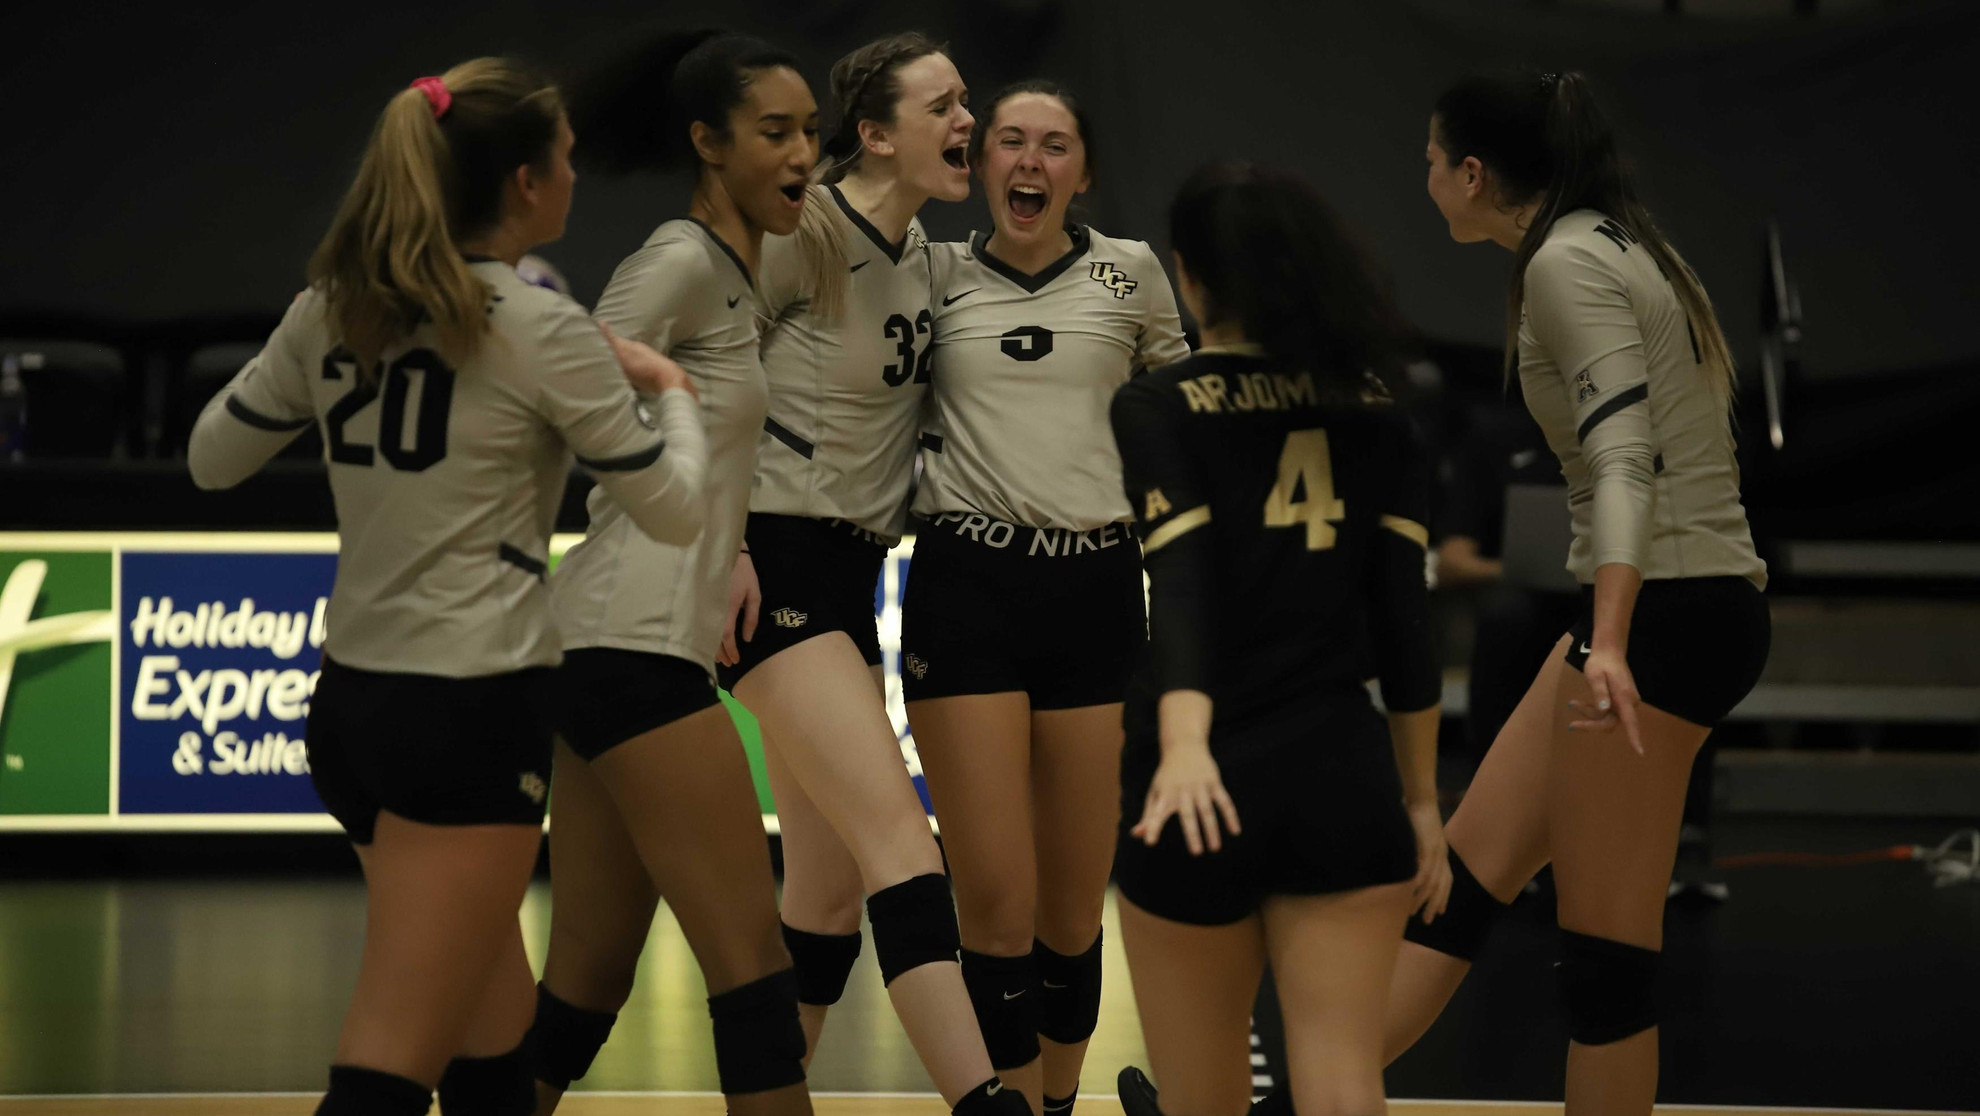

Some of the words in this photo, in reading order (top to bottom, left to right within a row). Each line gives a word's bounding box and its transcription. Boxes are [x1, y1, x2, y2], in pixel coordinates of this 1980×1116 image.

[1089, 261, 1138, 300] UCF
[882, 309, 933, 387] 32
[322, 344, 457, 472] 20
[1263, 426, 1346, 552] 4
[934, 512, 1016, 549] PRO
[1027, 526, 1121, 558] NIKE
[130, 596, 308, 660] Holiday
[770, 607, 807, 628] UCF
[905, 653, 929, 680] UCF
[172, 731, 204, 776] &
[208, 730, 312, 776] Suite
